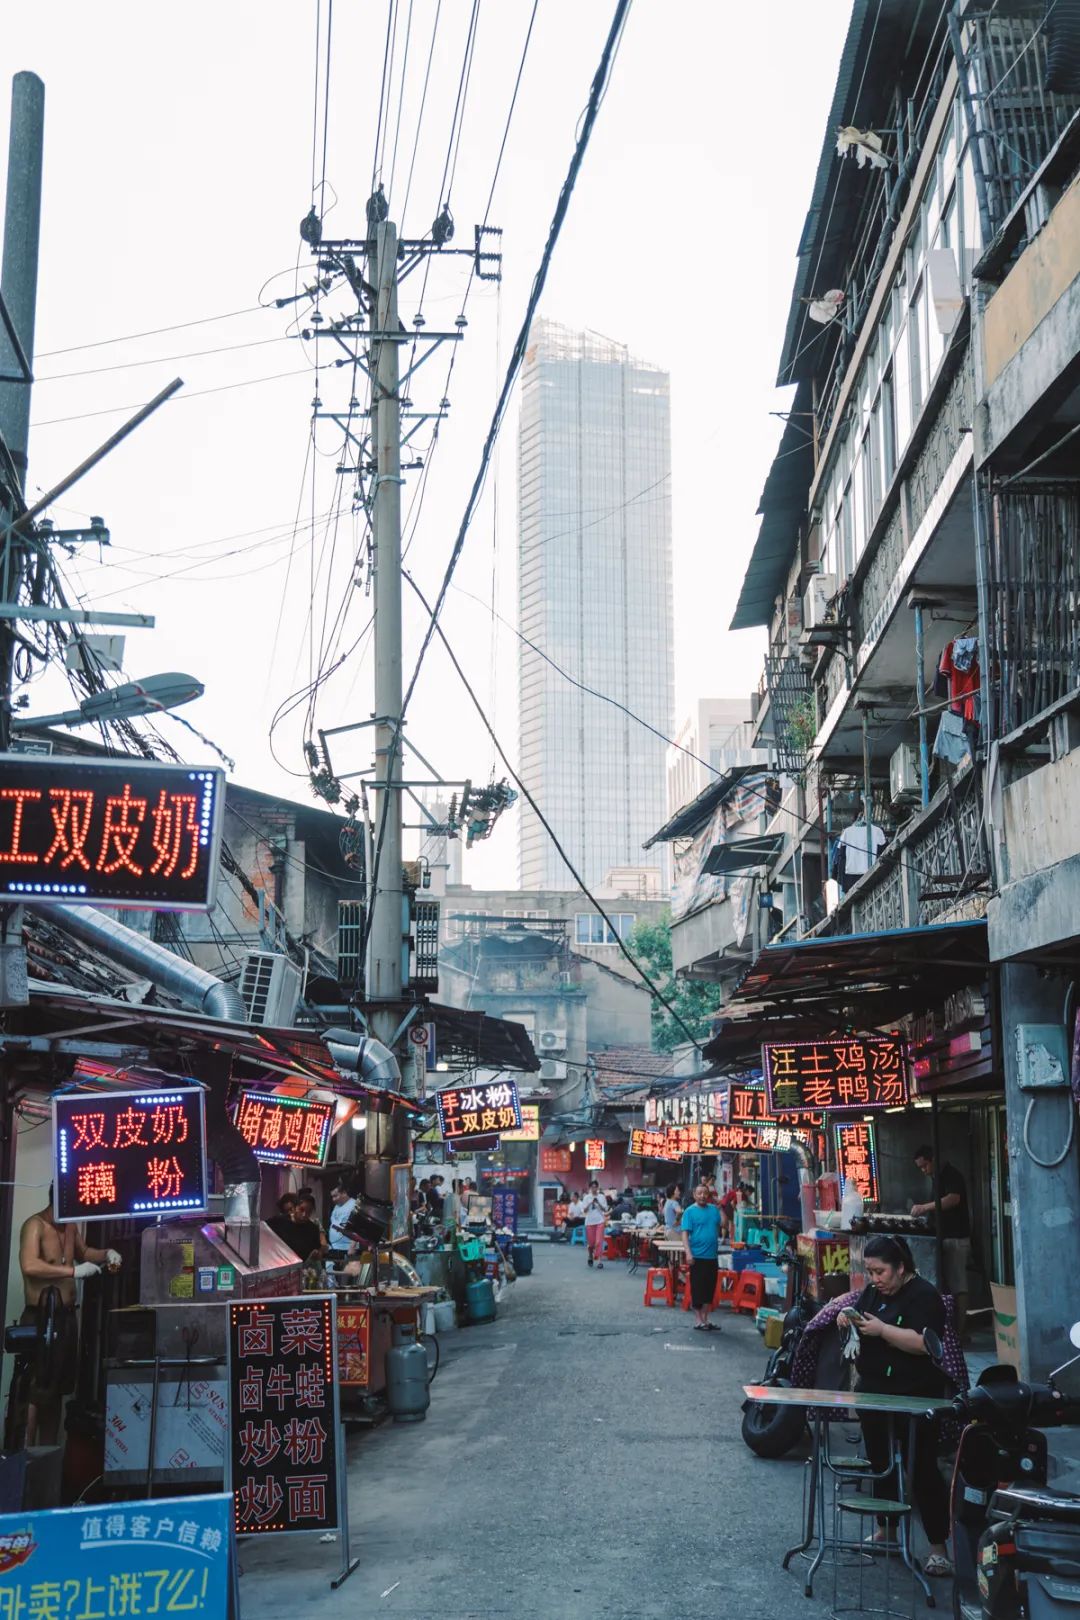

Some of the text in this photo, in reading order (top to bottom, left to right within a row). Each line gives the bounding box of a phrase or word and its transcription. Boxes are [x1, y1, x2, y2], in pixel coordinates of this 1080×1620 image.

[0, 784, 199, 879] 工双皮奶
[800, 1043, 900, 1075] 土鸡汤
[460, 1083, 513, 1111] 冰粉
[732, 1090, 823, 1125] 亚亚
[802, 1074, 903, 1105] 老鸭汤
[71, 1106, 190, 1151] 双皮奶
[240, 1100, 325, 1156] 销魂鸡腿
[461, 1106, 518, 1134] 双皮奶
[78, 1157, 184, 1205] 藕粉
[238, 1308, 324, 1358] 卤菜
[239, 1364, 325, 1413] 卤牛蛙
[239, 1416, 328, 1467] 炒粉
[240, 1474, 328, 1524] 炒面
[81, 1515, 222, 1553] 值得客户信赖
